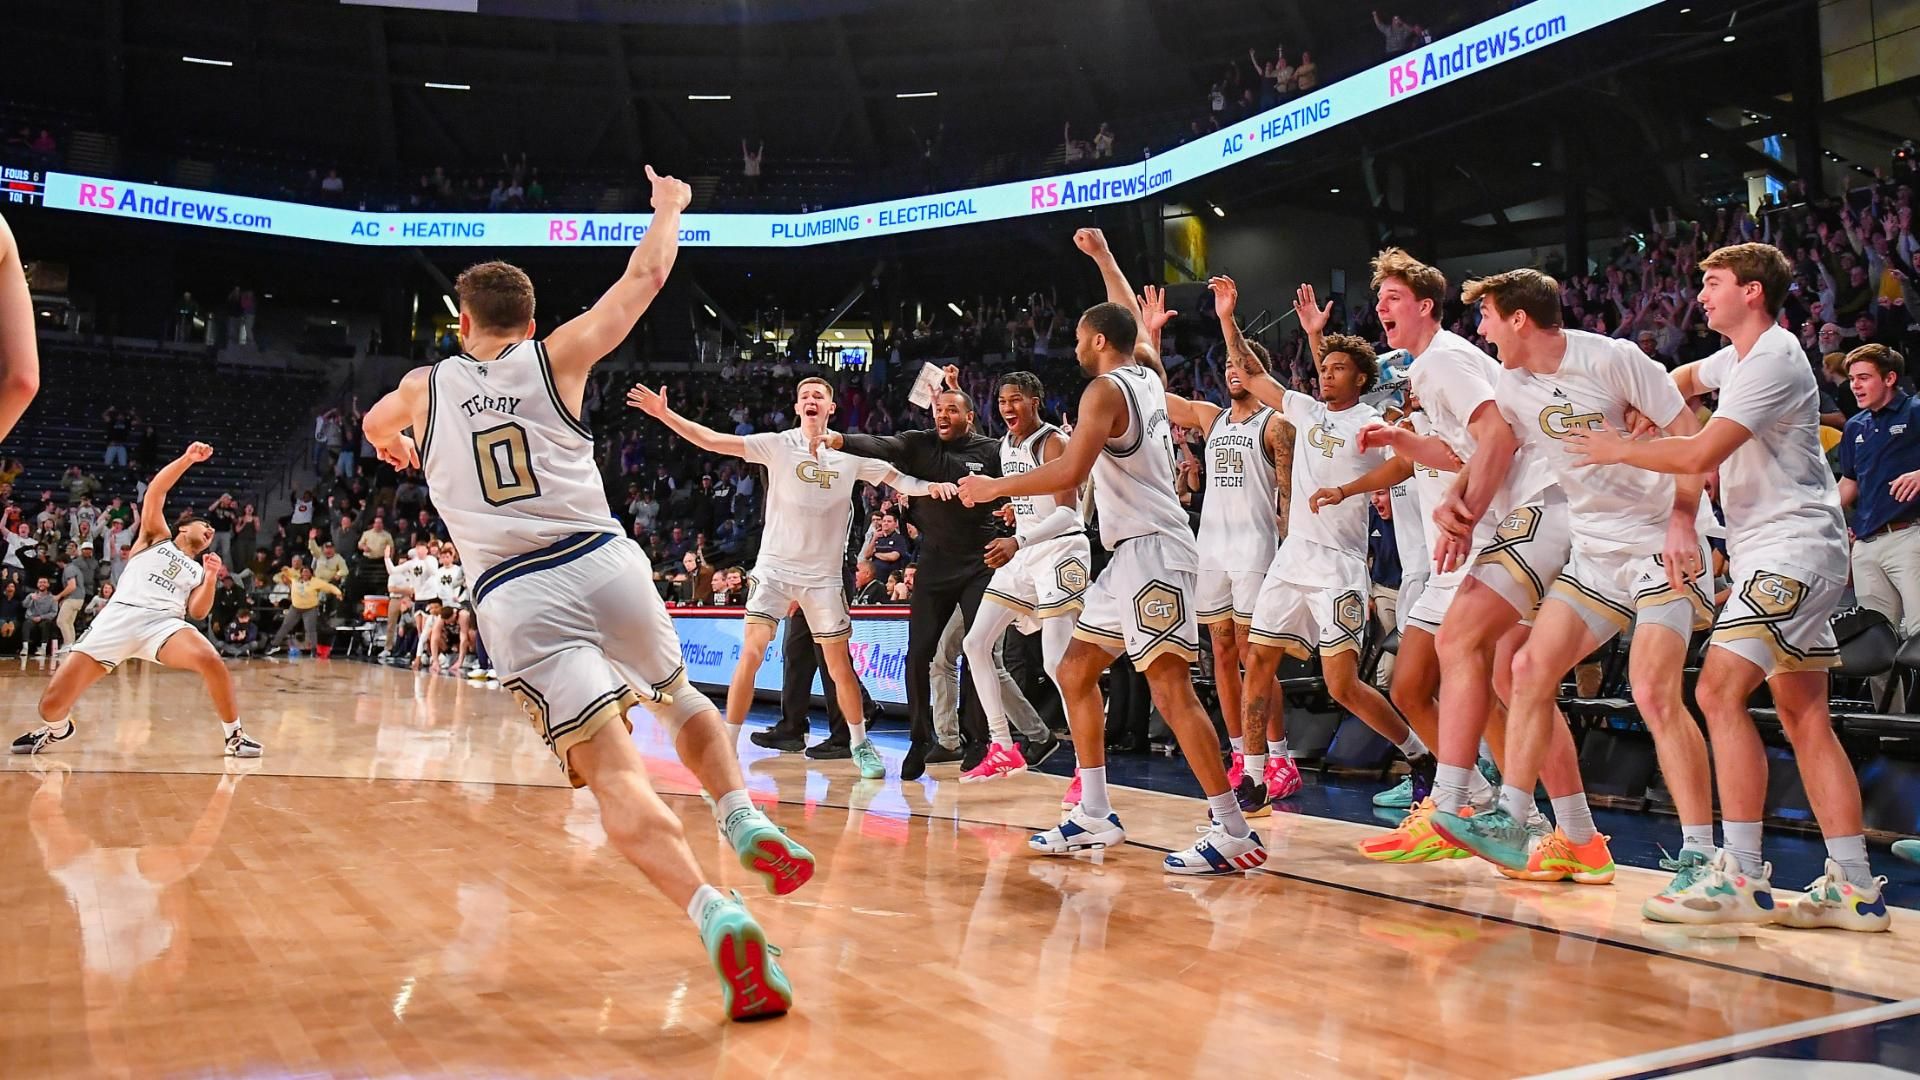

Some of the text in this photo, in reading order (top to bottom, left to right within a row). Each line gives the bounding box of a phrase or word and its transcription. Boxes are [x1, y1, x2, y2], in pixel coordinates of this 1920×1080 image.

[1223, 99, 1330, 157] AC HEATING
[5, 168, 39, 181] FOULS 6
[30, 195, 34, 205] 1
[351, 222, 485, 237] AC HEATING
[772, 199, 978, 239] PLUMBING ELECTRICAL
[550, 220, 711, 241] RSAndrecom
[461, 396, 521, 418] TERRY
[1209, 435, 1253, 449] GEORGIA
[1308, 423, 1345, 459] GT
[472, 421, 541, 507] 0
[1215, 448, 1243, 473] 24
[796, 460, 839, 489] GT
[1214, 477, 1243, 487] TECH
[157, 547, 197, 579] GEORGIA
[162, 560, 182, 580] 3
[148, 573, 176, 594] TECH
[1063, 569, 1083, 586] GT
[1758, 577, 1793, 605] GT
[1144, 600, 1174, 618] GT
